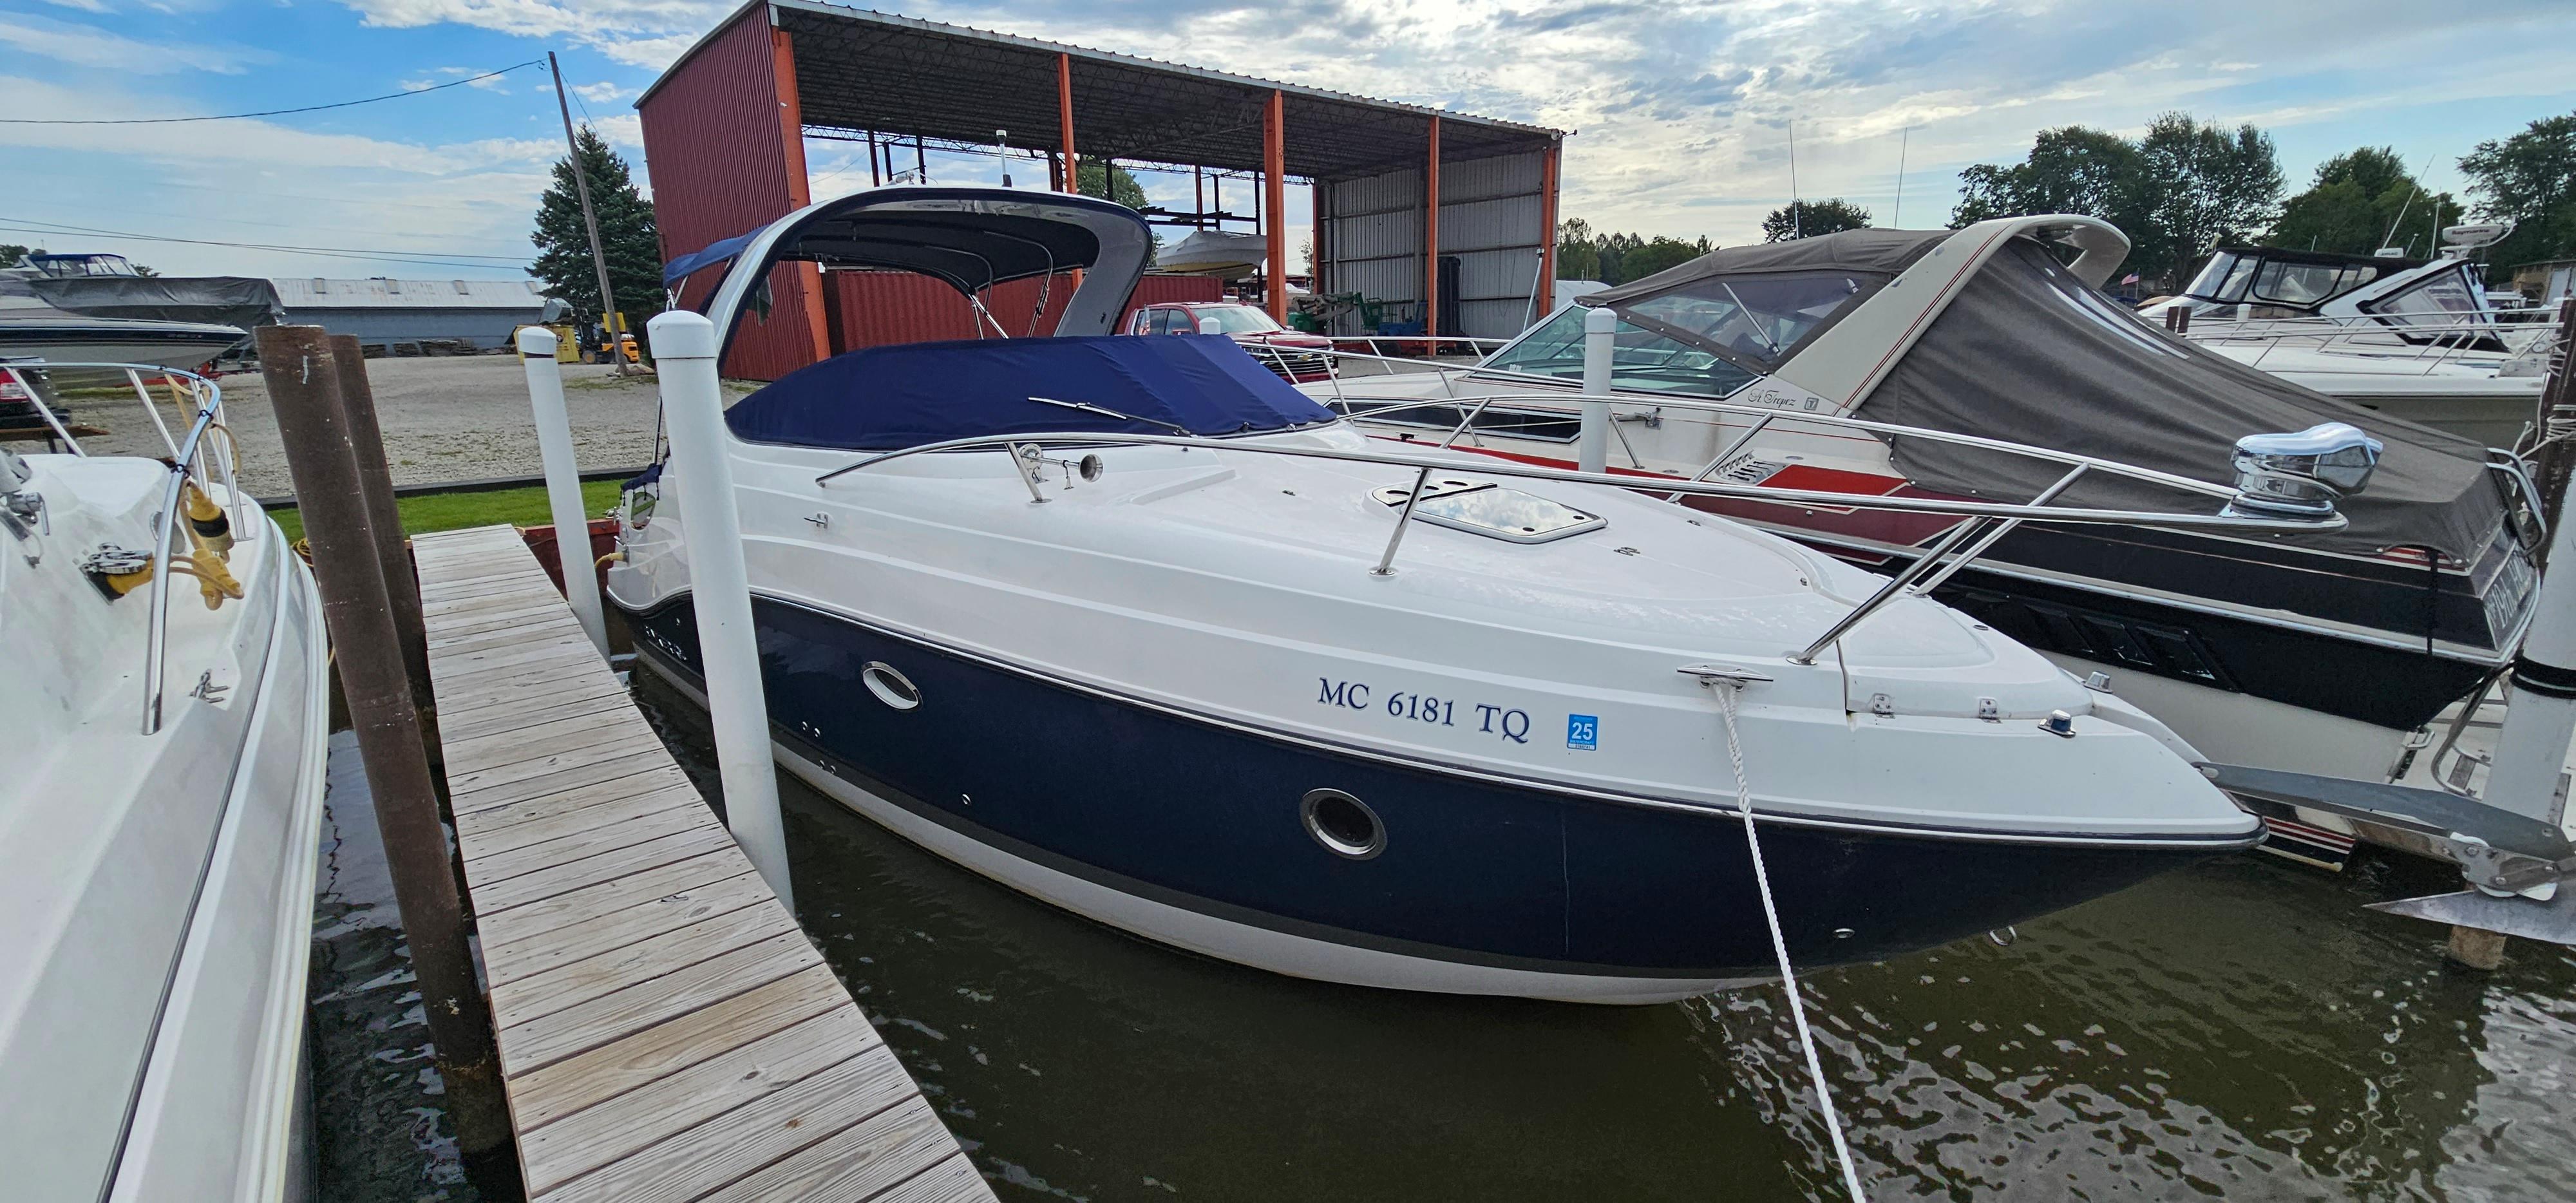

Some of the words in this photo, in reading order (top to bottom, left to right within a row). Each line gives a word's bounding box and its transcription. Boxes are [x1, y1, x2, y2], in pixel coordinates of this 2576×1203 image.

[1318, 677, 1370, 710] MC
[1387, 690, 1455, 727] 6181
[1475, 702, 1531, 744] TQ
[1571, 722, 1593, 741] 25
